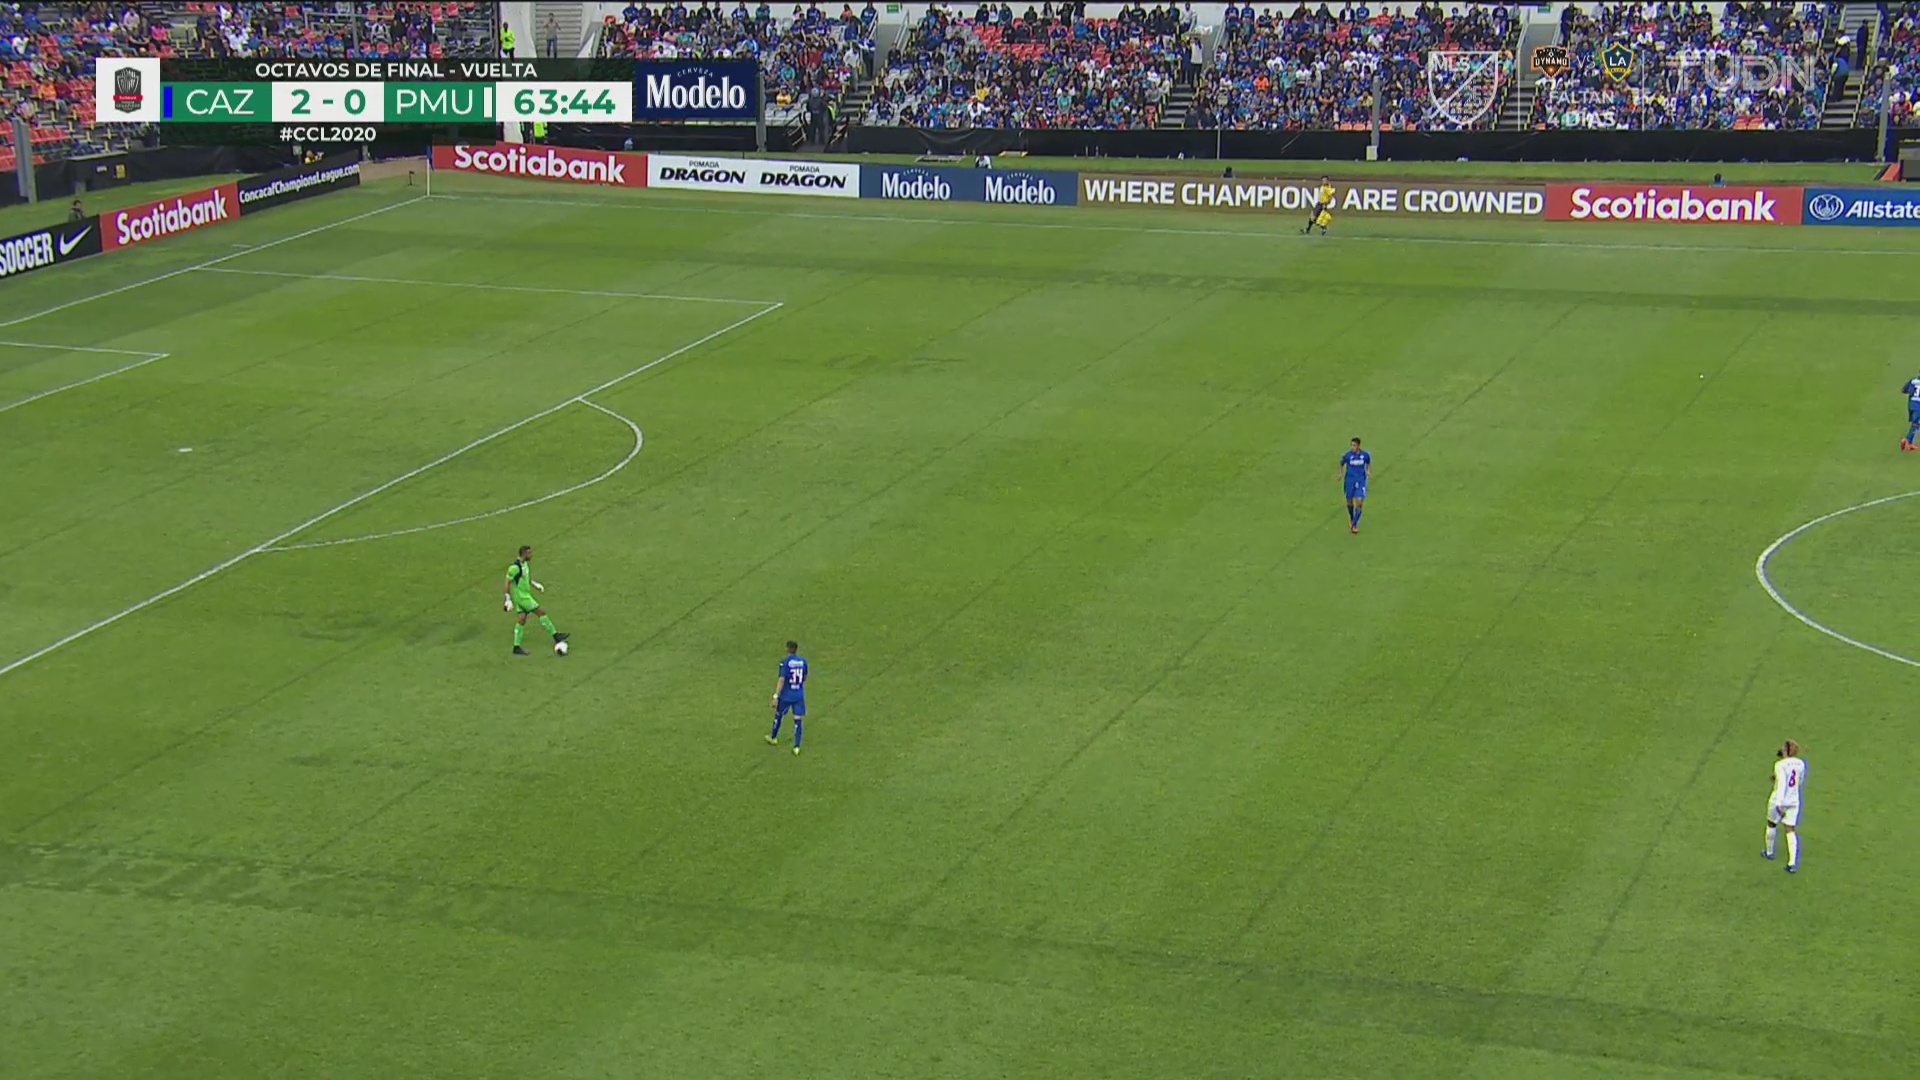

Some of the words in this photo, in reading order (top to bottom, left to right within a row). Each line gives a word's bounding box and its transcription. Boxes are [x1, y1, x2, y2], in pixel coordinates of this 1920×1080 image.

[454, 145, 625, 184] Scotiabank
[659, 167, 746, 184] DRAGON
[689, 160, 719, 169] POMADA
[789, 164, 820, 174] POMADA
[239, 163, 360, 203] ConcacafChampionsLeague.com
[759, 172, 847, 189] DRAGON
[882, 172, 951, 200] Modelo
[985, 176, 1056, 205] Modelo
[1084, 180, 1175, 204] WHERE
[1342, 188, 1398, 211] ARE
[1403, 190, 1544, 215] CROWNED
[1570, 188, 1777, 221] Scotiabank
[1845, 200, 1920, 219] Allstate
[117, 189, 228, 245] Scotiabank
[0, 232, 55, 276] SOCCER
[789, 668, 803, 683] 34
